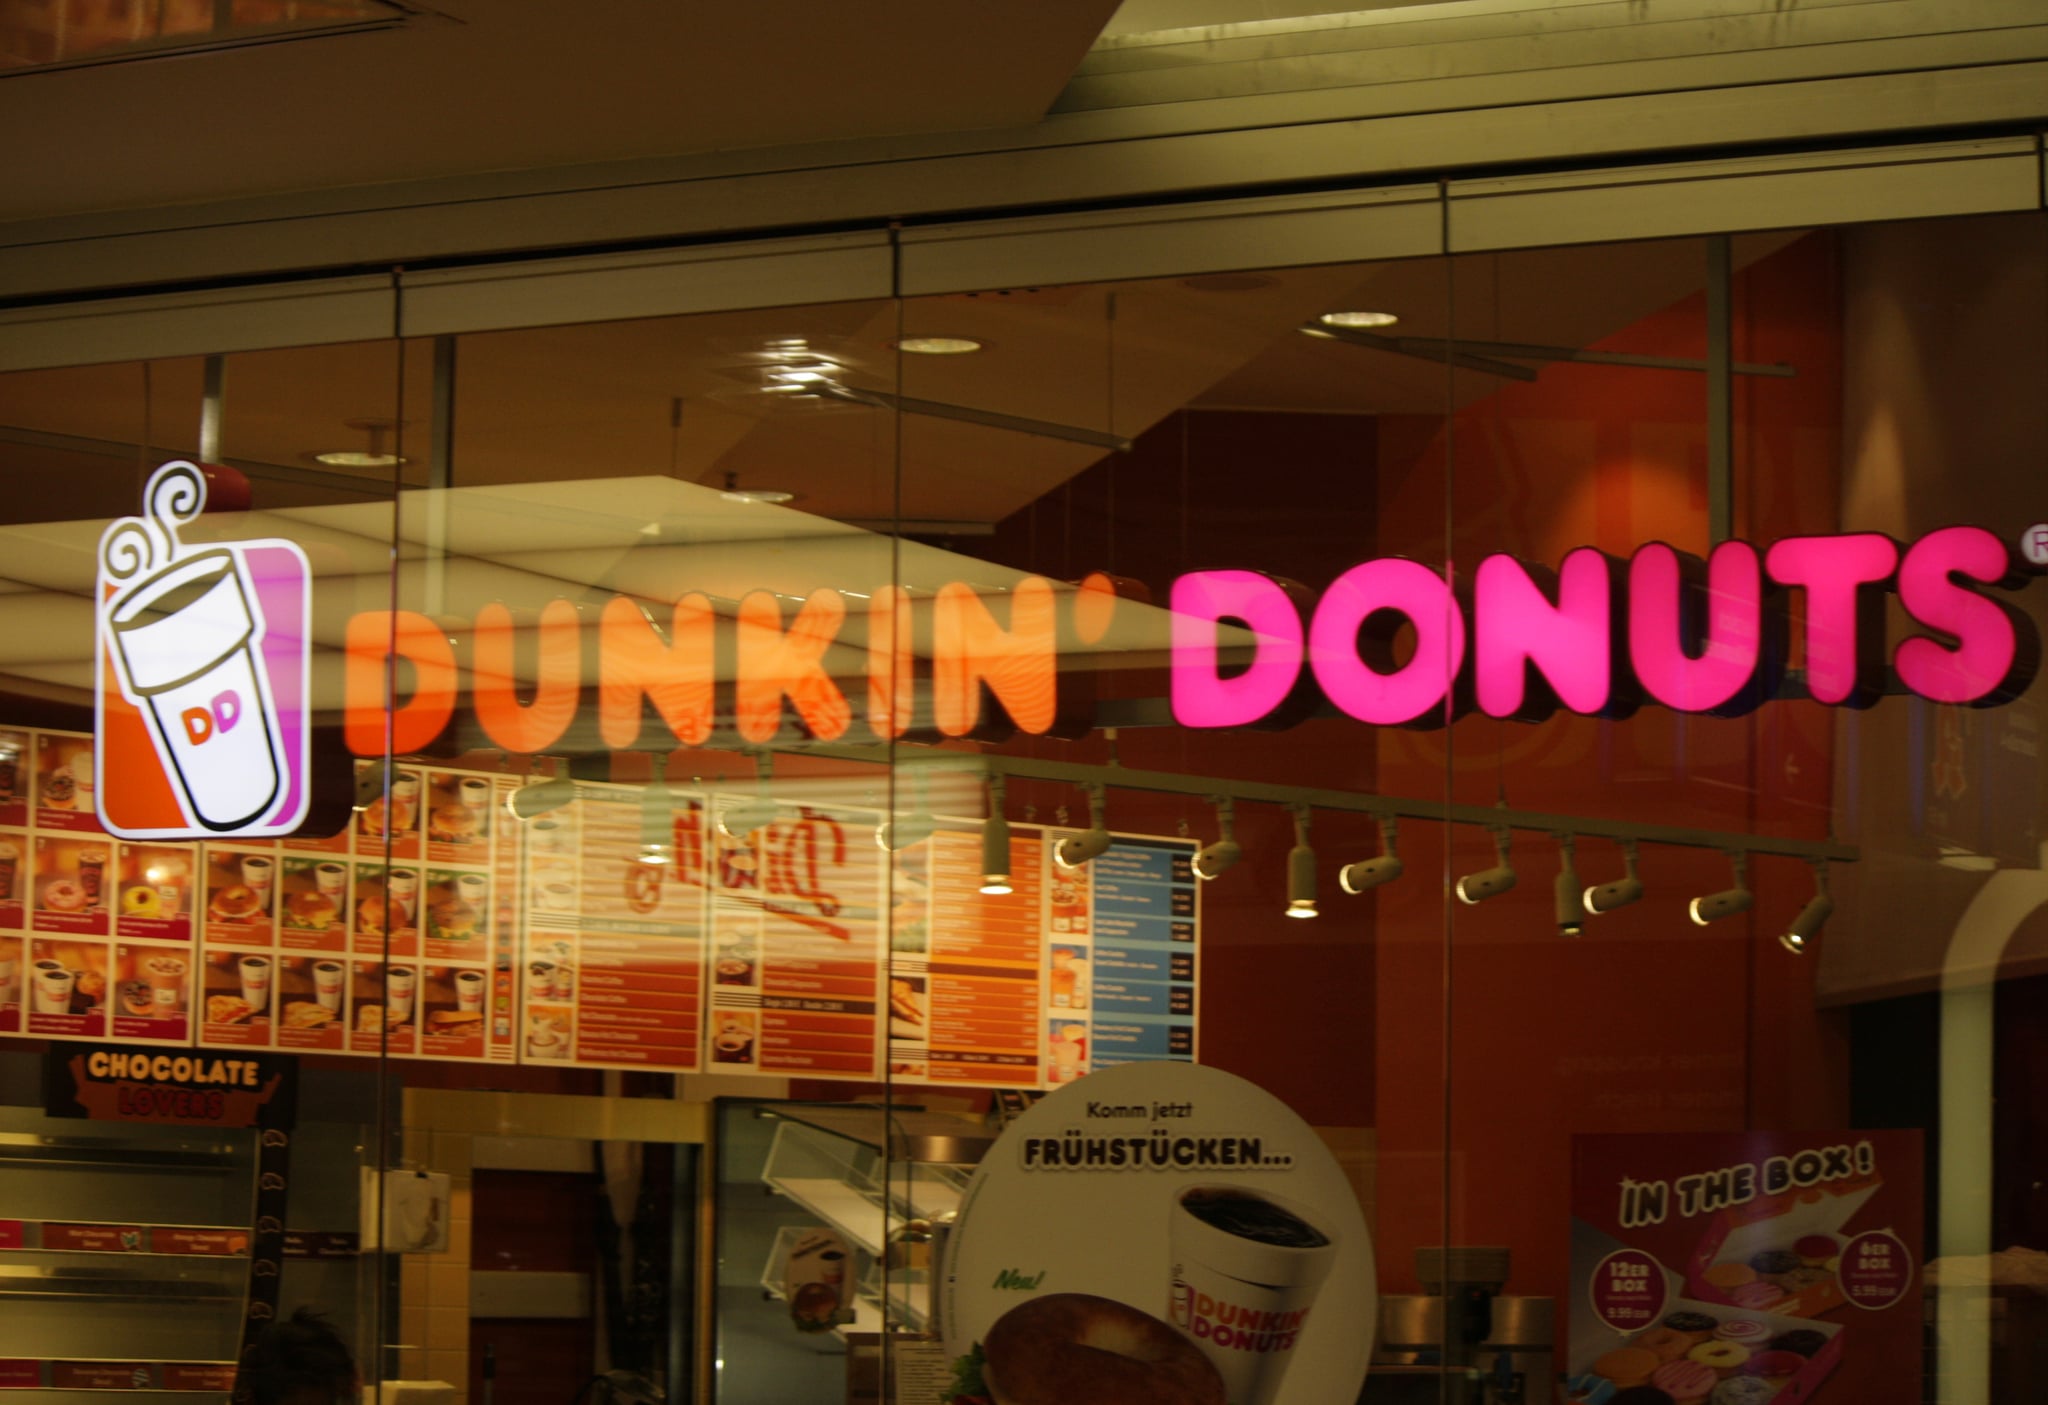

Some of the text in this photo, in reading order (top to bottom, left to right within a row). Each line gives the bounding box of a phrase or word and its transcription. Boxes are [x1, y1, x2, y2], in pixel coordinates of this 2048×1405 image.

[343, 571, 1117, 757] DUNKIN'
[1170, 525, 2017, 729] DONUTS
[87, 1050, 260, 1088] CHOCOLATE
[117, 1084, 226, 1122] LOVERS
[1087, 1100, 1193, 1123] Komm jetzt
[1620, 1180, 1669, 1228] IN
[1675, 1163, 1756, 1217] THE
[1858, 1257, 1892, 1270] BOX
[1611, 1279, 1648, 1293] BOX
[1193, 1315, 1300, 1353] DONUTS
